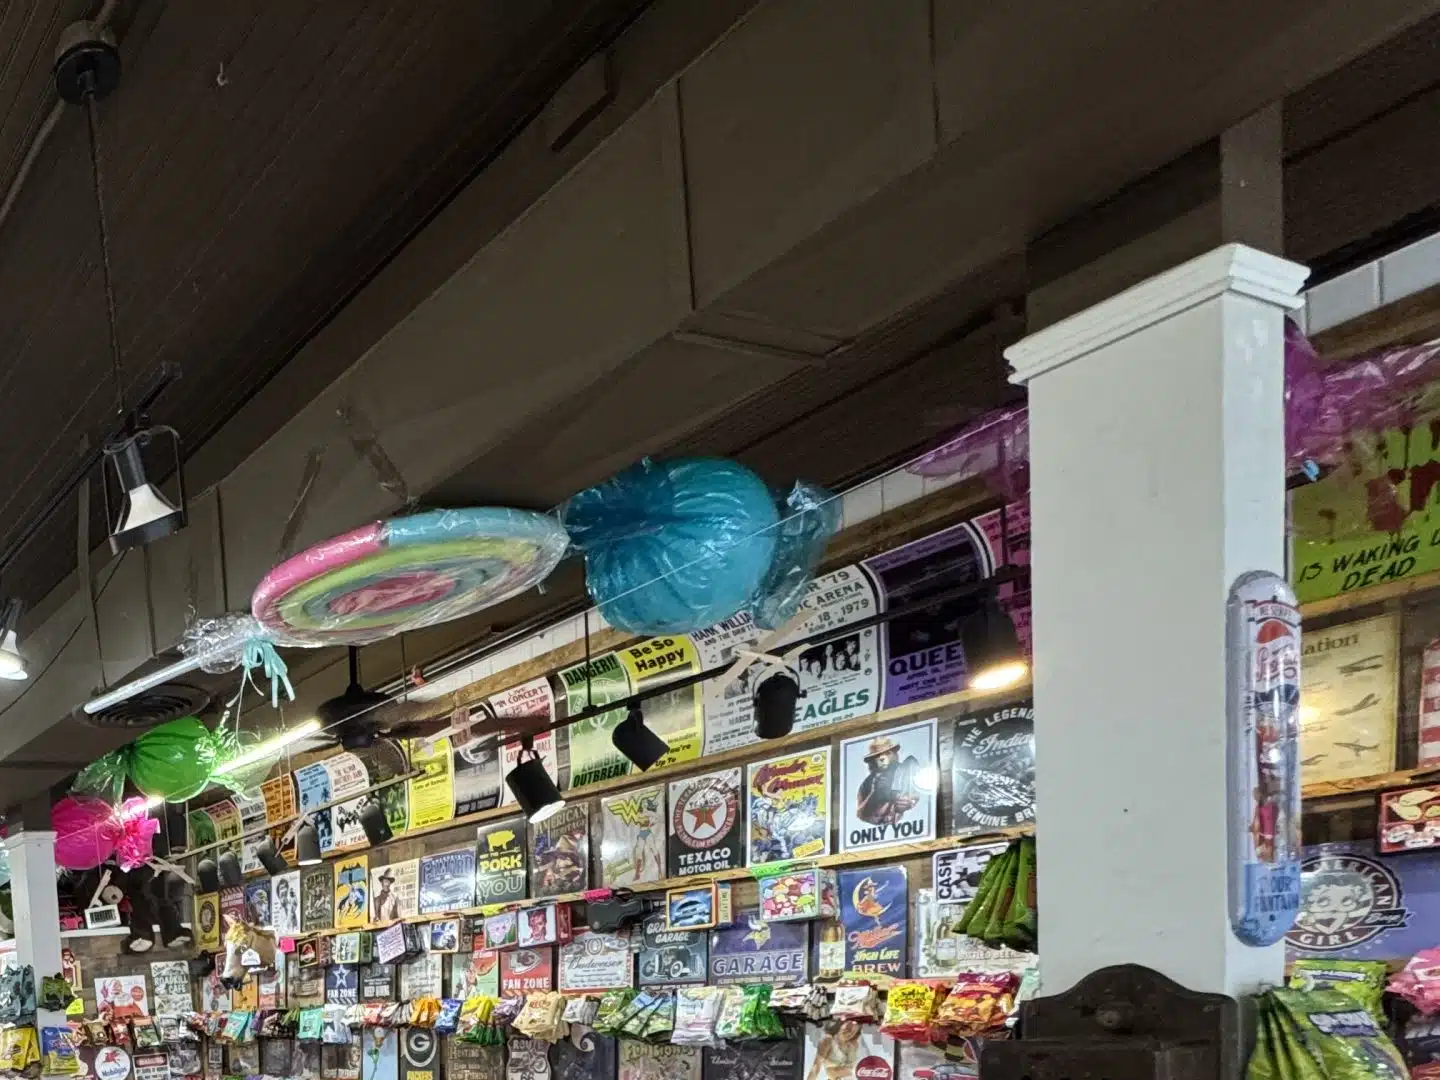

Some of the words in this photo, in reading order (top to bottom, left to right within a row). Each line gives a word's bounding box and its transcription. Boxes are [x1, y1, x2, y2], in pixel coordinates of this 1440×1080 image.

[1300, 565, 1323, 583] IS
[1332, 535, 1421, 573] WAKING
[1341, 556, 1417, 592] DEAD
[813, 581, 865, 605] ARENA
[841, 598, 870, 617] 1979
[691, 625, 717, 642] HANK
[719, 611, 753, 632] WILLIA
[629, 643, 652, 659] Be
[652, 637, 675, 651] So
[635, 647, 686, 673] Happy
[889, 642, 961, 677] QUEE
[792, 688, 871, 724] EAGLES
[961, 727, 982, 748] THE
[985, 708, 1035, 727] LEGEND
[573, 764, 628, 788] OUTBREAK
[961, 803, 1008, 827] GENUINE
[850, 826, 886, 845] ONLY
[892, 819, 924, 839] YOU
[479, 854, 522, 873] PORK
[678, 847, 731, 866] TEXACO
[678, 863, 712, 876] MOTOR
[713, 860, 731, 870] OIL
[478, 875, 523, 898] YOU
[938, 856, 952, 900] CASH
[1300, 931, 1358, 946] GIRL
[712, 952, 804, 976] GARAGE
[851, 962, 901, 974] BREW
[503, 979, 521, 990] FAN
[523, 977, 550, 989] ZONE
